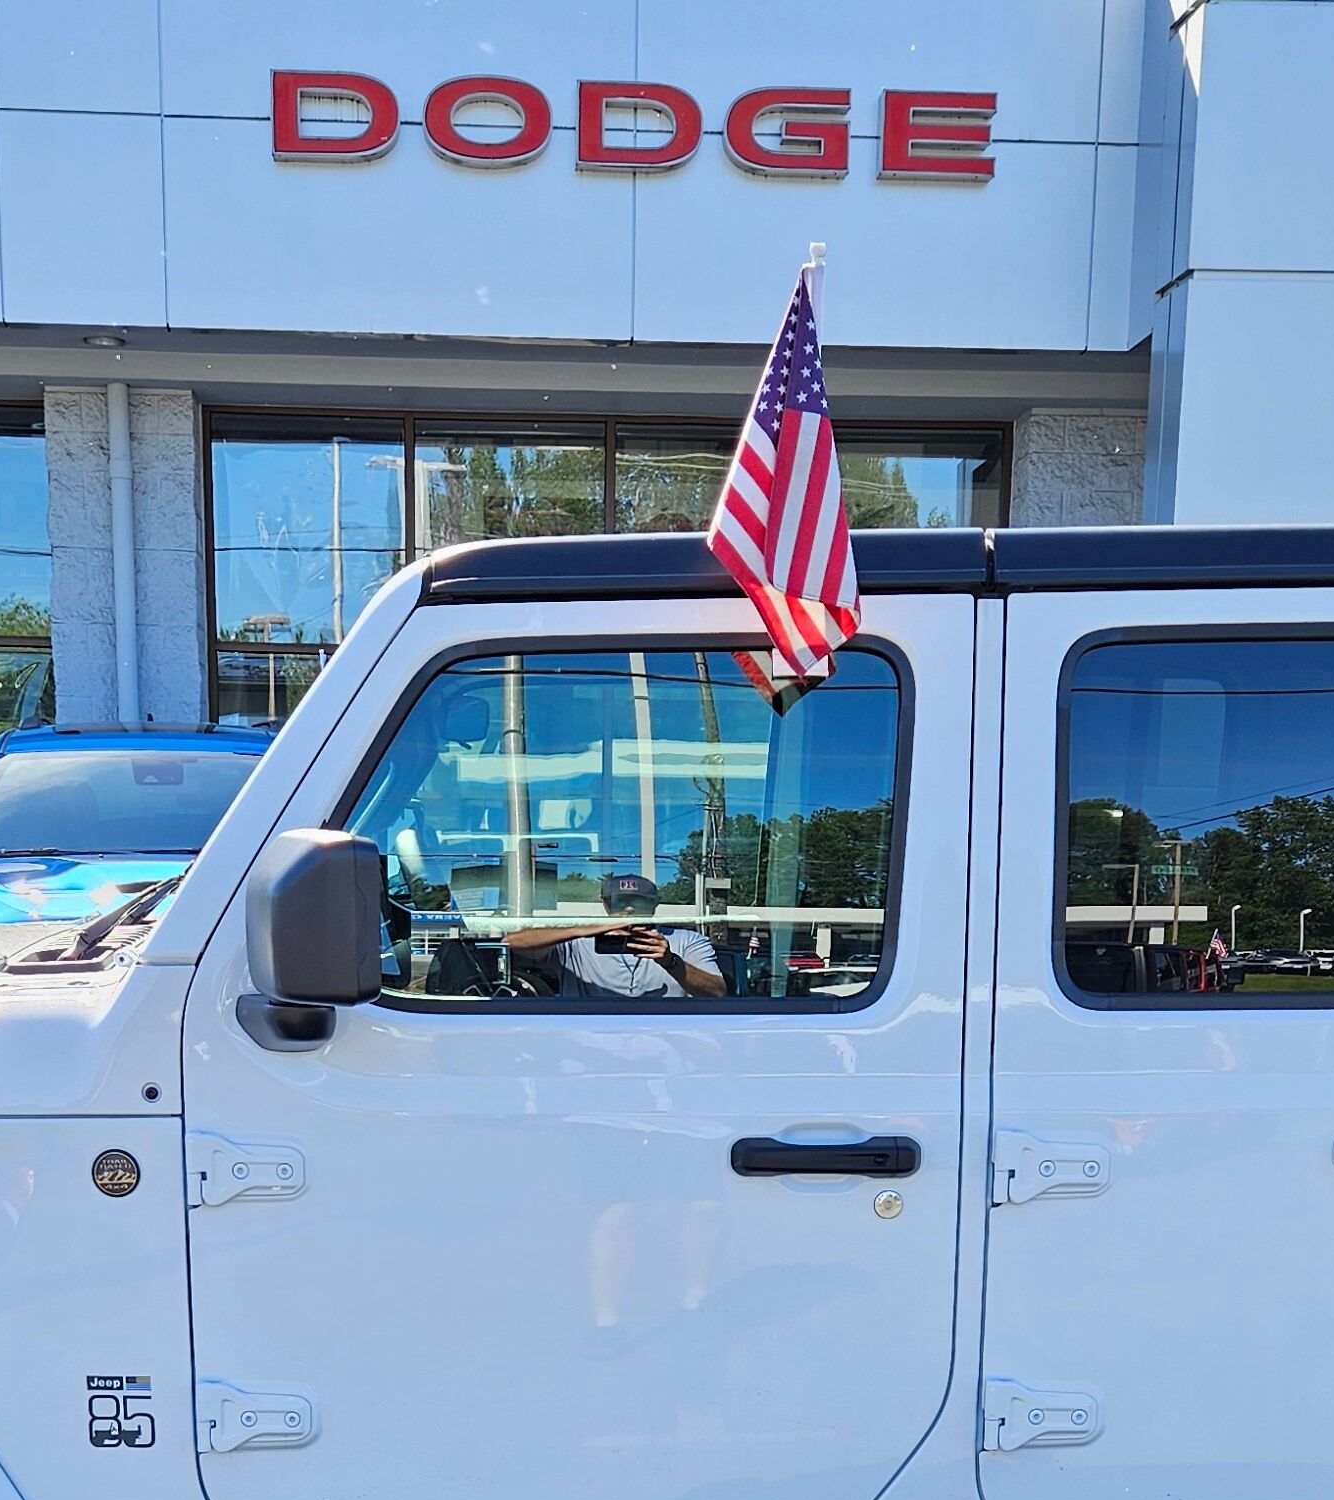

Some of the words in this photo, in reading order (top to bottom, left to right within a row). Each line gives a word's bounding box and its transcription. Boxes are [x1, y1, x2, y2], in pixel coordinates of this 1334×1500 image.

[270, 69, 998, 183] DODGE
[89, 1377, 121, 1389] Jeep
[88, 1394, 156, 1448] 85
